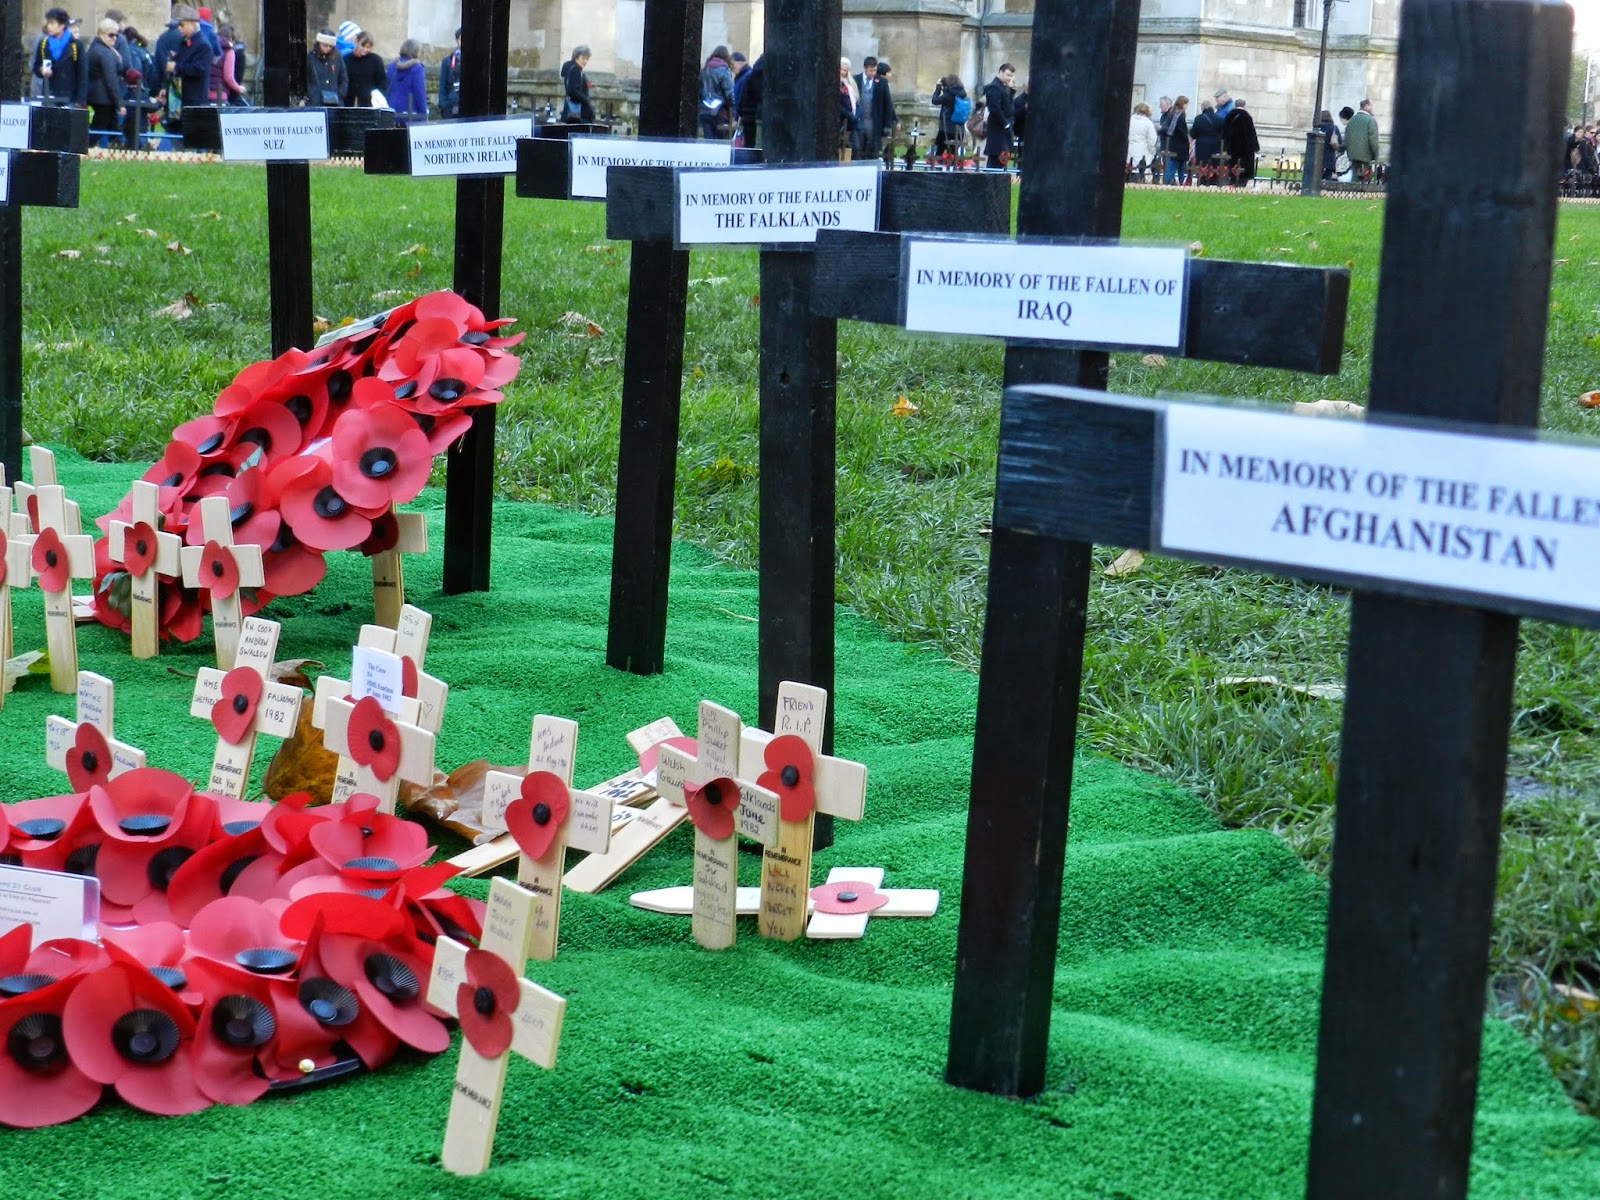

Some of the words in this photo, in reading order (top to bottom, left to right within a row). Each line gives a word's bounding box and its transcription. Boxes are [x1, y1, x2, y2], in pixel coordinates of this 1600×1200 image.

[0, 118, 19, 126] ALLEN
[224, 127, 232, 136] IN
[233, 127, 261, 136] MEMORY
[263, 127, 272, 135] OF
[273, 126, 286, 135] THE
[288, 126, 314, 135] FALLEN
[315, 125, 324, 134] OF
[263, 139, 285, 150] SUEZ
[414, 140, 422, 150] IN
[424, 139, 457, 149] MEMORY
[458, 138, 468, 148] OF
[470, 137, 486, 147] THE
[424, 152, 475, 165] NORTHERN
[477, 149, 517, 163] IRELAN
[578, 155, 588, 166] IN
[591, 156, 639, 167] MEMORY
[685, 194, 698, 206] IN
[701, 192, 755, 206] MEMORY
[758, 192, 775, 205] OF
[777, 191, 801, 204] THE
[805, 189, 853, 204] FALLEN
[855, 188, 873, 202] OF
[714, 213, 745, 228] THE
[750, 210, 841, 228] FALKLANDS
[916, 269, 934, 285] IN
[938, 270, 1016, 289] MEMORY
[1019, 273, 1043, 290] OF
[1046, 275, 1081, 292] THE
[1085, 277, 1151, 296] FALLEN
[1154, 280, 1178, 297] OF
[1016, 299, 1073, 326] IRAQ
[1178, 447, 1209, 475] IN
[1218, 452, 1358, 494] MEMORY
[1365, 470, 1409, 502] OF
[1415, 476, 1480, 512] THE
[1487, 485, 1600, 529] FALLE
[1270, 503, 1560, 571] AFGHANISTAN
[782, 696, 814, 711] FRIEND
[265, 708, 285, 723] 1982
[661, 754, 686, 773] Welsh
[738, 786, 776, 813] alklands
[740, 820, 760, 836] 1982
